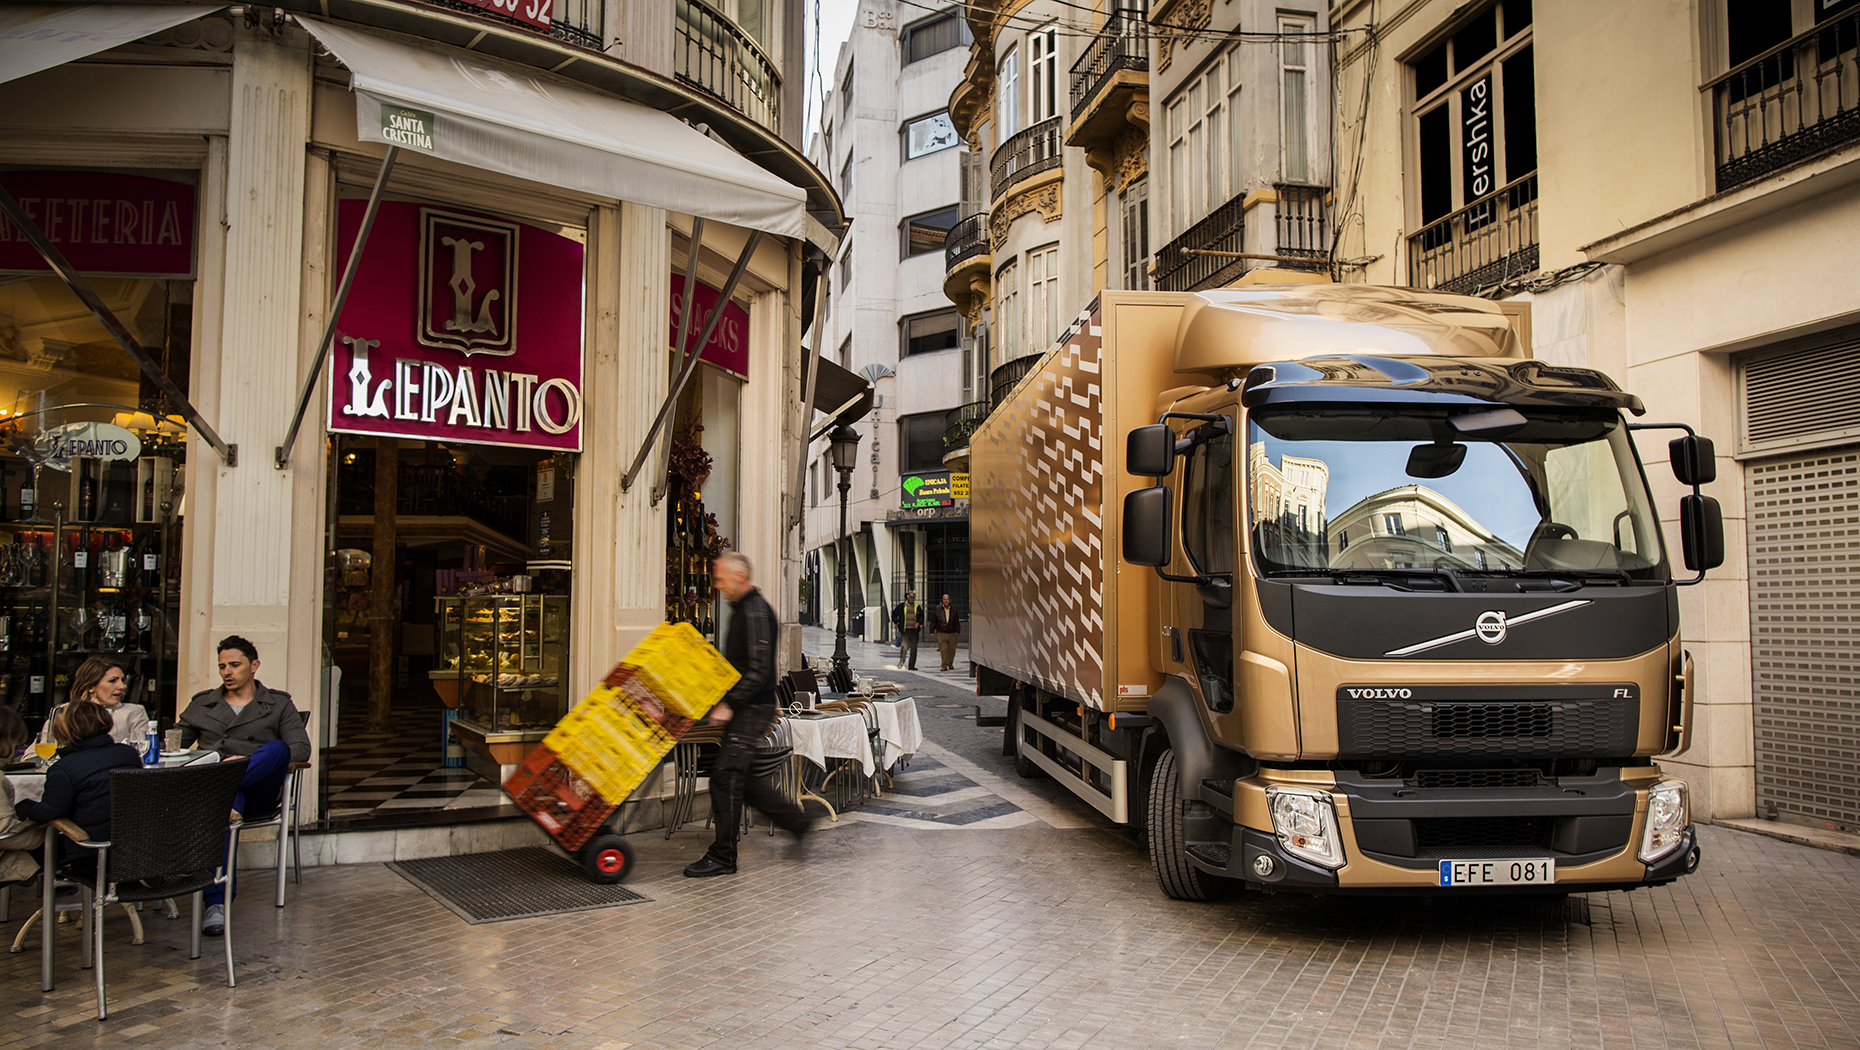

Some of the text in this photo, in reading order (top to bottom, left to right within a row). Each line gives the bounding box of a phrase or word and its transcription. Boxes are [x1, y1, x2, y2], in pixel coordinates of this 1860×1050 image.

[389, 114, 425, 134] SANTA
[382, 126, 433, 150] CRISTINA
[342, 335, 582, 435] LEPANTO
[1347, 688, 1413, 699] VOLVO
[1613, 688, 1633, 698] FL
[1454, 863, 1494, 883] EFE
[1510, 862, 1548, 882] 081
